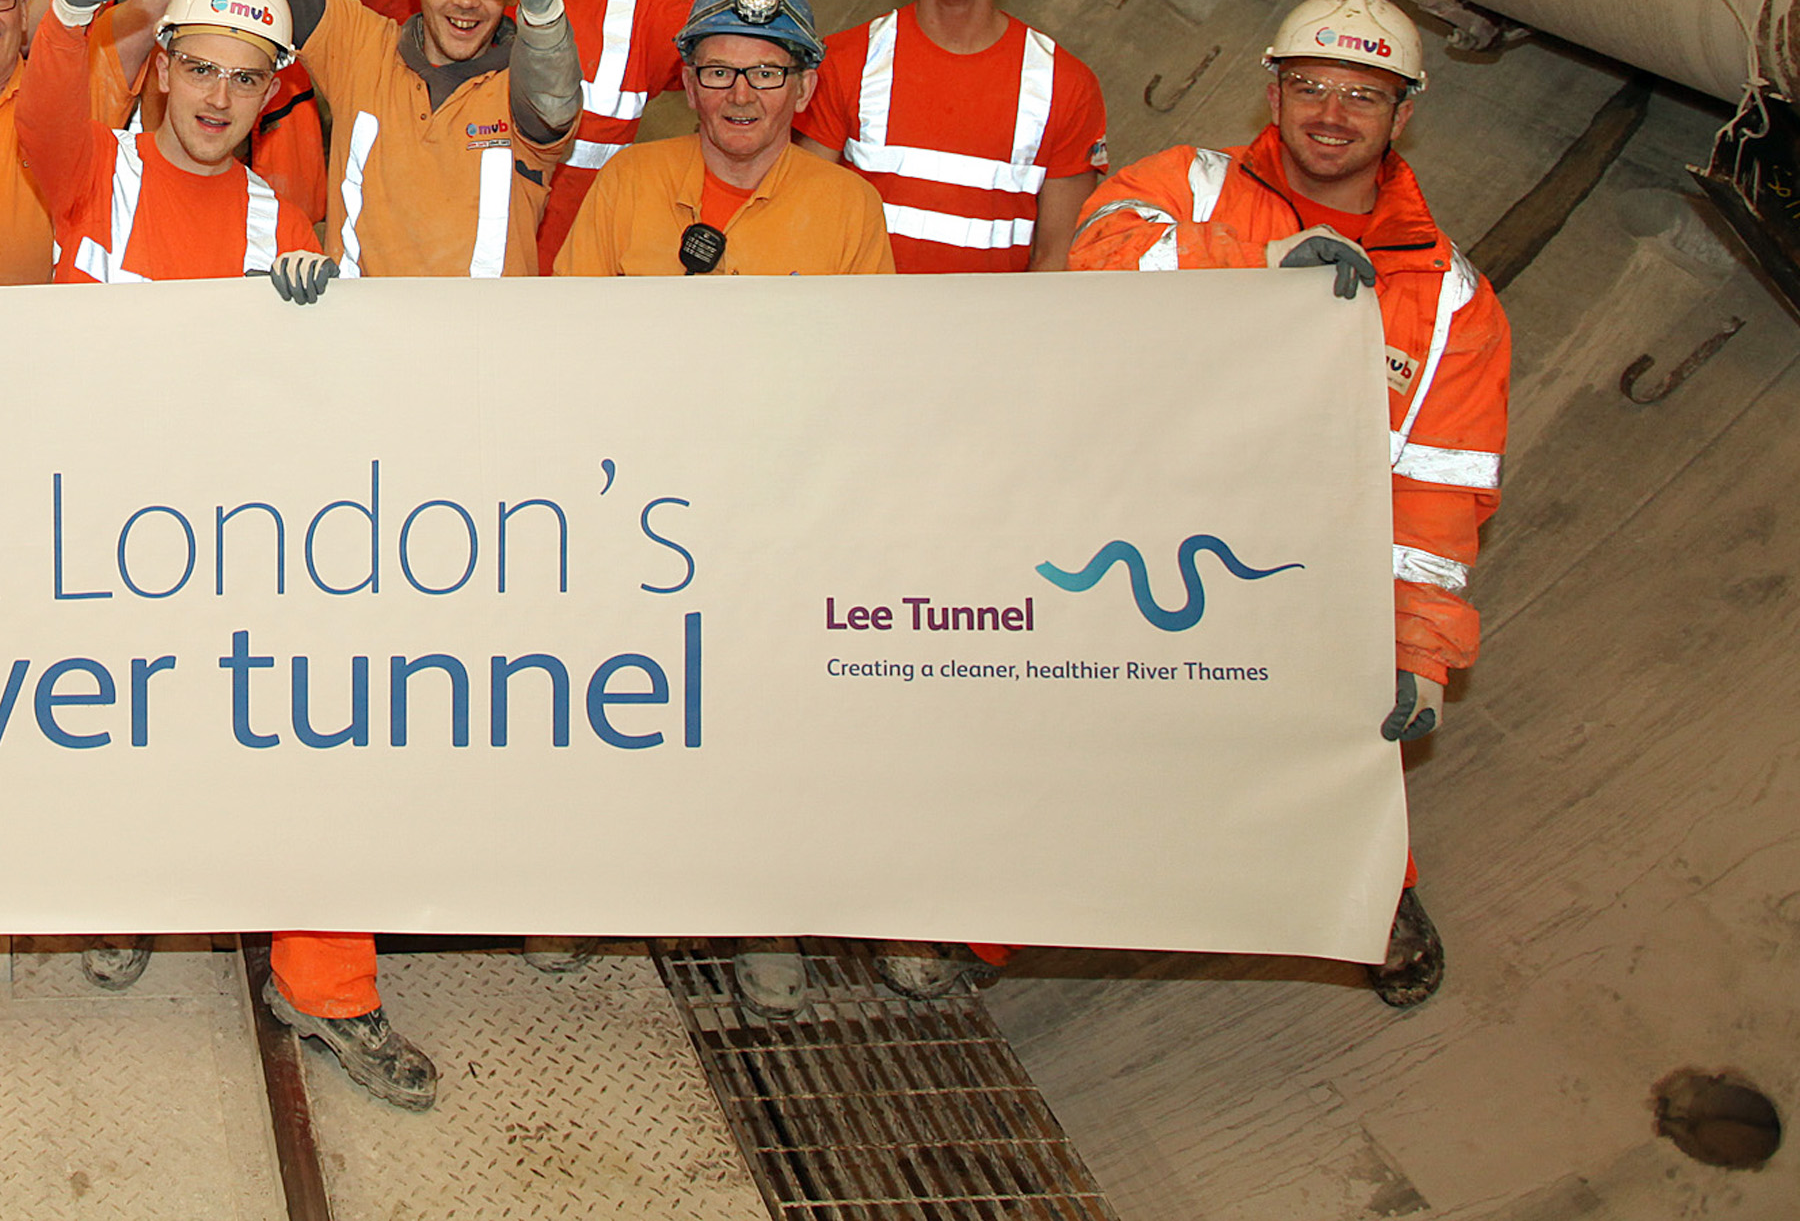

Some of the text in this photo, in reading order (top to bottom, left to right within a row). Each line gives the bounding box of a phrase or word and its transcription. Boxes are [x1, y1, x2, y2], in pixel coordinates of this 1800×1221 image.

[230, 2, 274, 27] mvb
[1337, 34, 1392, 58] mvb
[478, 119, 509, 135] mvb
[826, 596, 1035, 632] Lee Tunnel
[218, 611, 702, 750] tunnel
[826, 658, 1269, 682] Creating a cleaner, healthier River Thames
